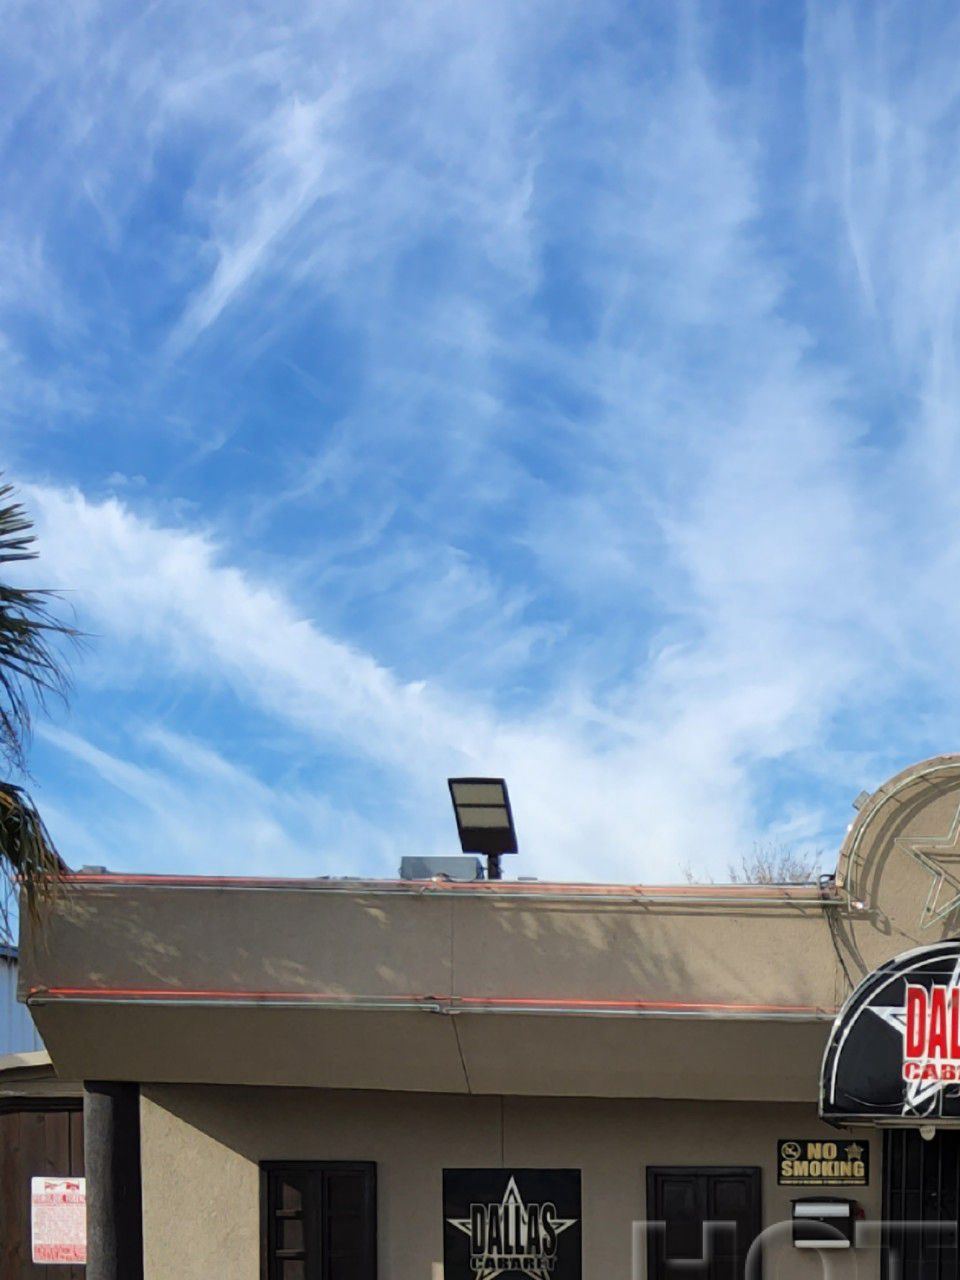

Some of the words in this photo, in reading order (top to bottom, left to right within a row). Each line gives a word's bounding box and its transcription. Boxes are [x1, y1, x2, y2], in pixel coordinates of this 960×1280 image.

[807, 1142, 837, 1160] NO
[781, 1160, 865, 1177] SMOKING
[470, 1203, 557, 1256] DALLAS
[470, 1256, 557, 1271] CABARET
